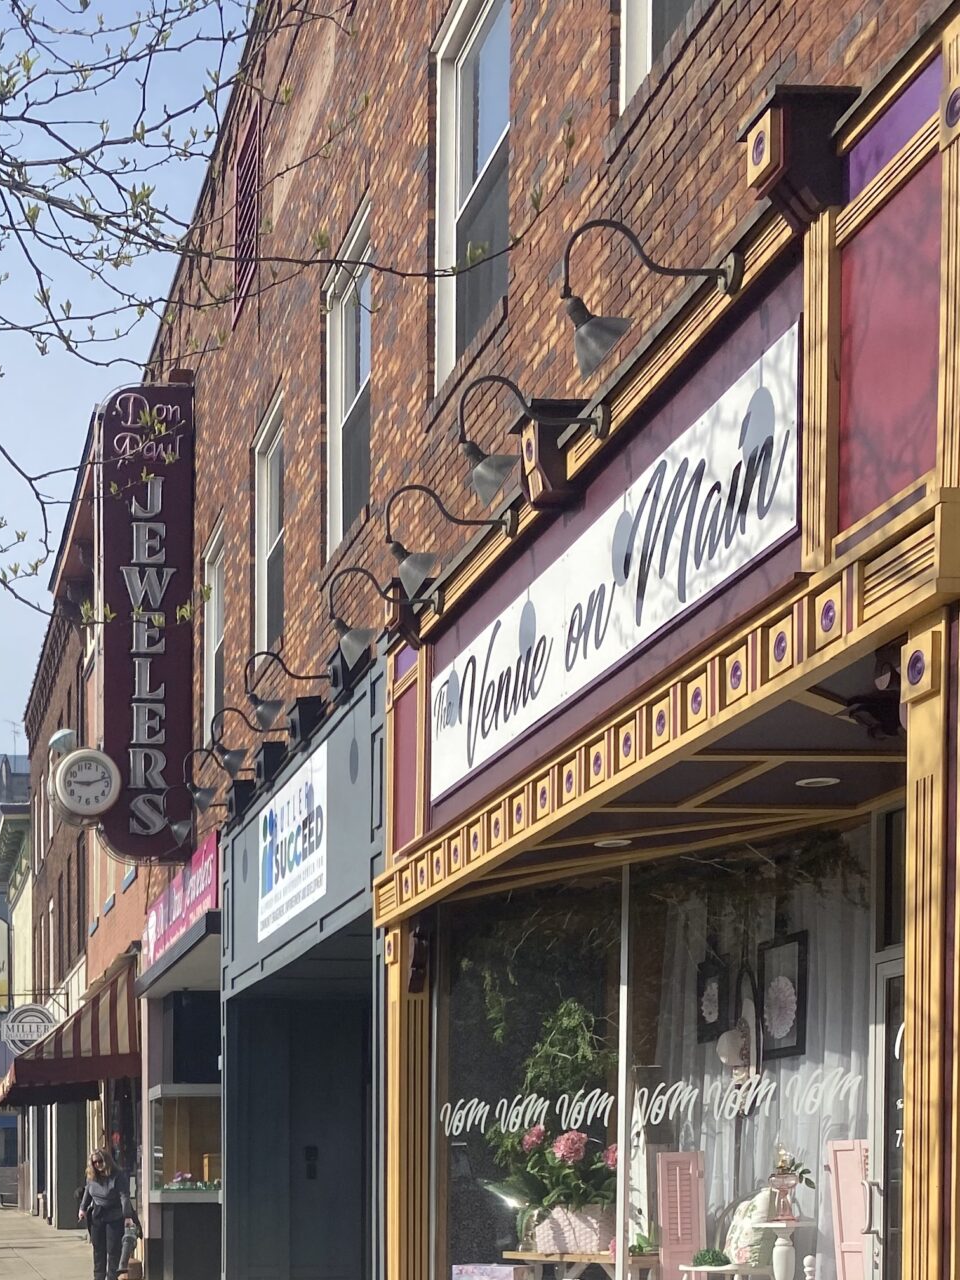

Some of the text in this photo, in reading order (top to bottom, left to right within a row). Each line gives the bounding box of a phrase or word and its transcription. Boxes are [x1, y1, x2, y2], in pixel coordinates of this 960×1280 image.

[113, 393, 181, 428] Don
[114, 432, 183, 469] Paul
[458, 620, 553, 768] Venue
[565, 582, 616, 673] on
[624, 411, 790, 628] Main
[120, 476, 177, 836] JEWELERS
[275, 804, 324, 885] SUCCEED
